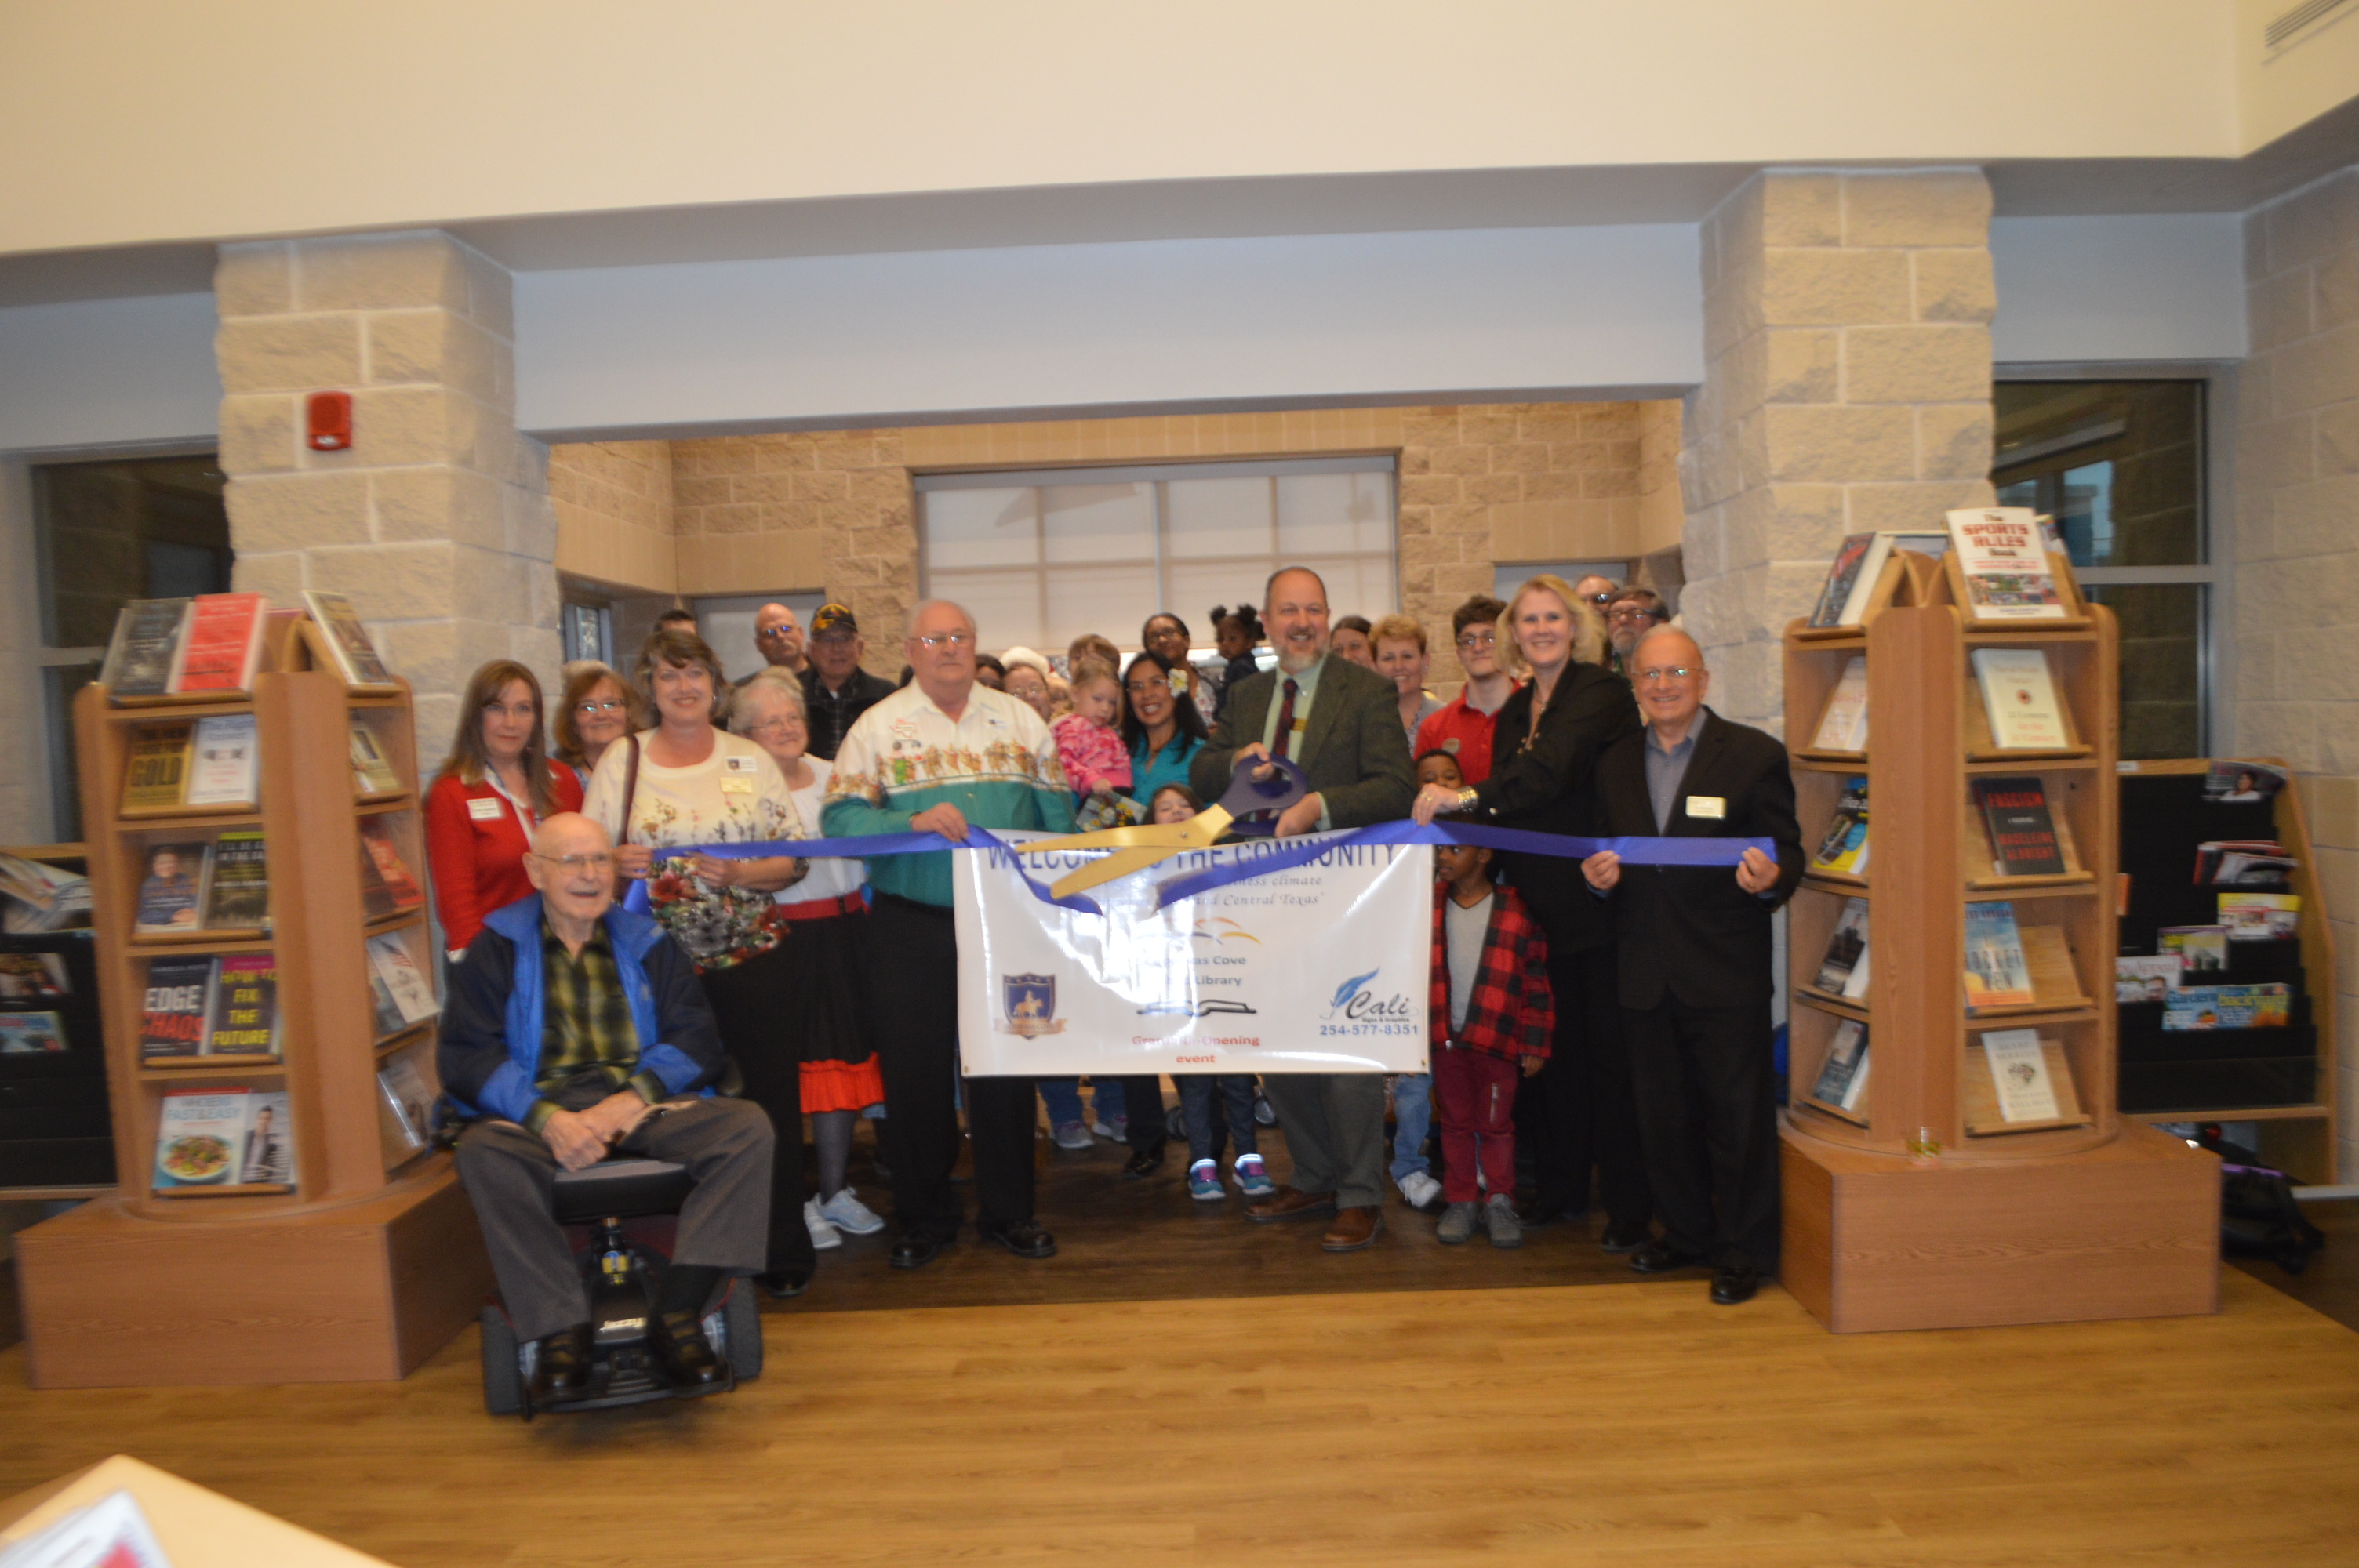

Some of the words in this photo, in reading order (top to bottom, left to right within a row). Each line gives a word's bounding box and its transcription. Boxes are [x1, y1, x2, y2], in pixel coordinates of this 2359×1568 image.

[1962, 524, 2029, 535] SPORTS
[1973, 537, 2026, 547] RULES
[1236, 837, 1397, 866] COMMUNITY
[1272, 873, 1322, 886] climate
[1223, 893, 1275, 906] Central
[1212, 955, 1247, 965] Cove
[1196, 975, 1242, 987] Library
[143, 985, 203, 1012] EDGE
[1345, 990, 1409, 1019] Cali
[229, 1008, 260, 1024] THE
[1319, 1024, 1419, 1036] 254-577-8351
[212, 1029, 271, 1046] FUTURE
[1176, 1054, 1216, 1064] event
